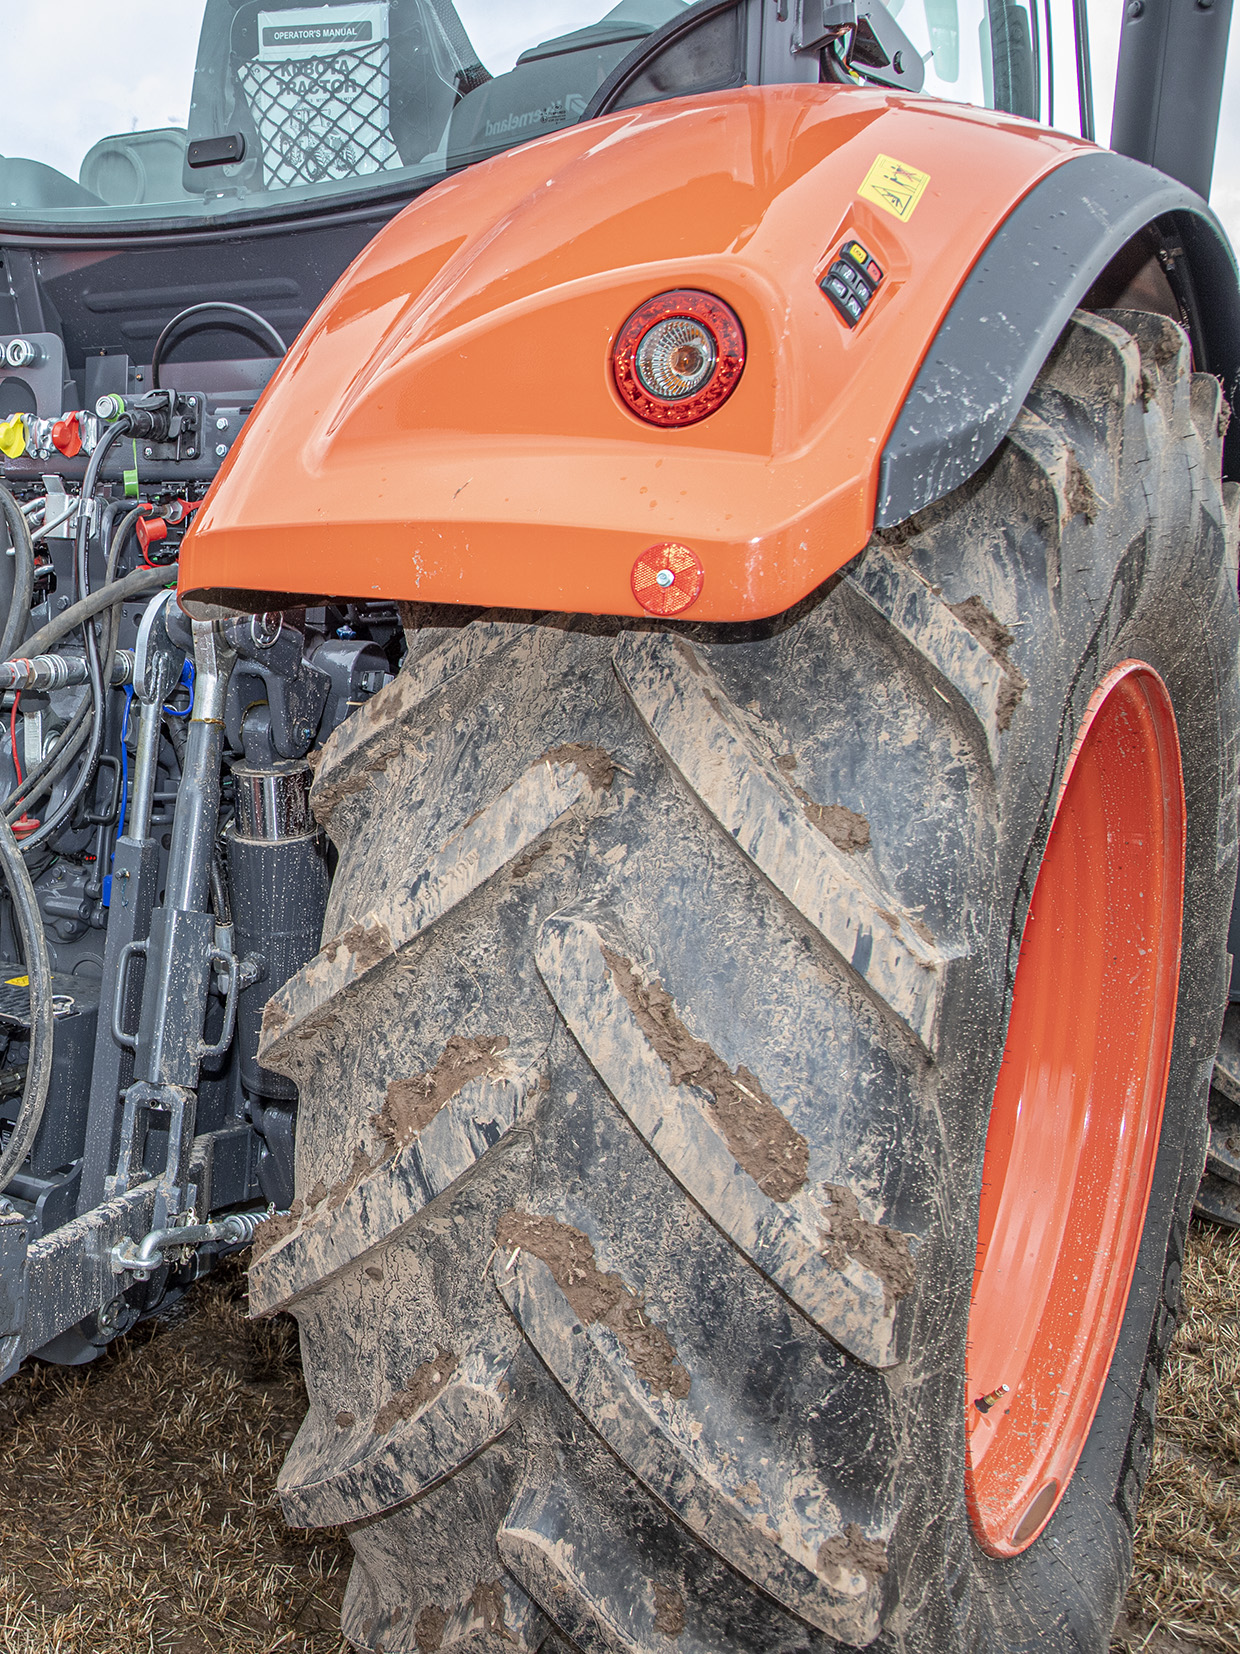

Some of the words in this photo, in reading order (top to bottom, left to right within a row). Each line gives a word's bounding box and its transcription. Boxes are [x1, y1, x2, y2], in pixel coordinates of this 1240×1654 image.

[273, 29, 321, 40] OPERATOR'S
[322, 27, 358, 38] MANUAL
[276, 78, 357, 96] TRACTOR
